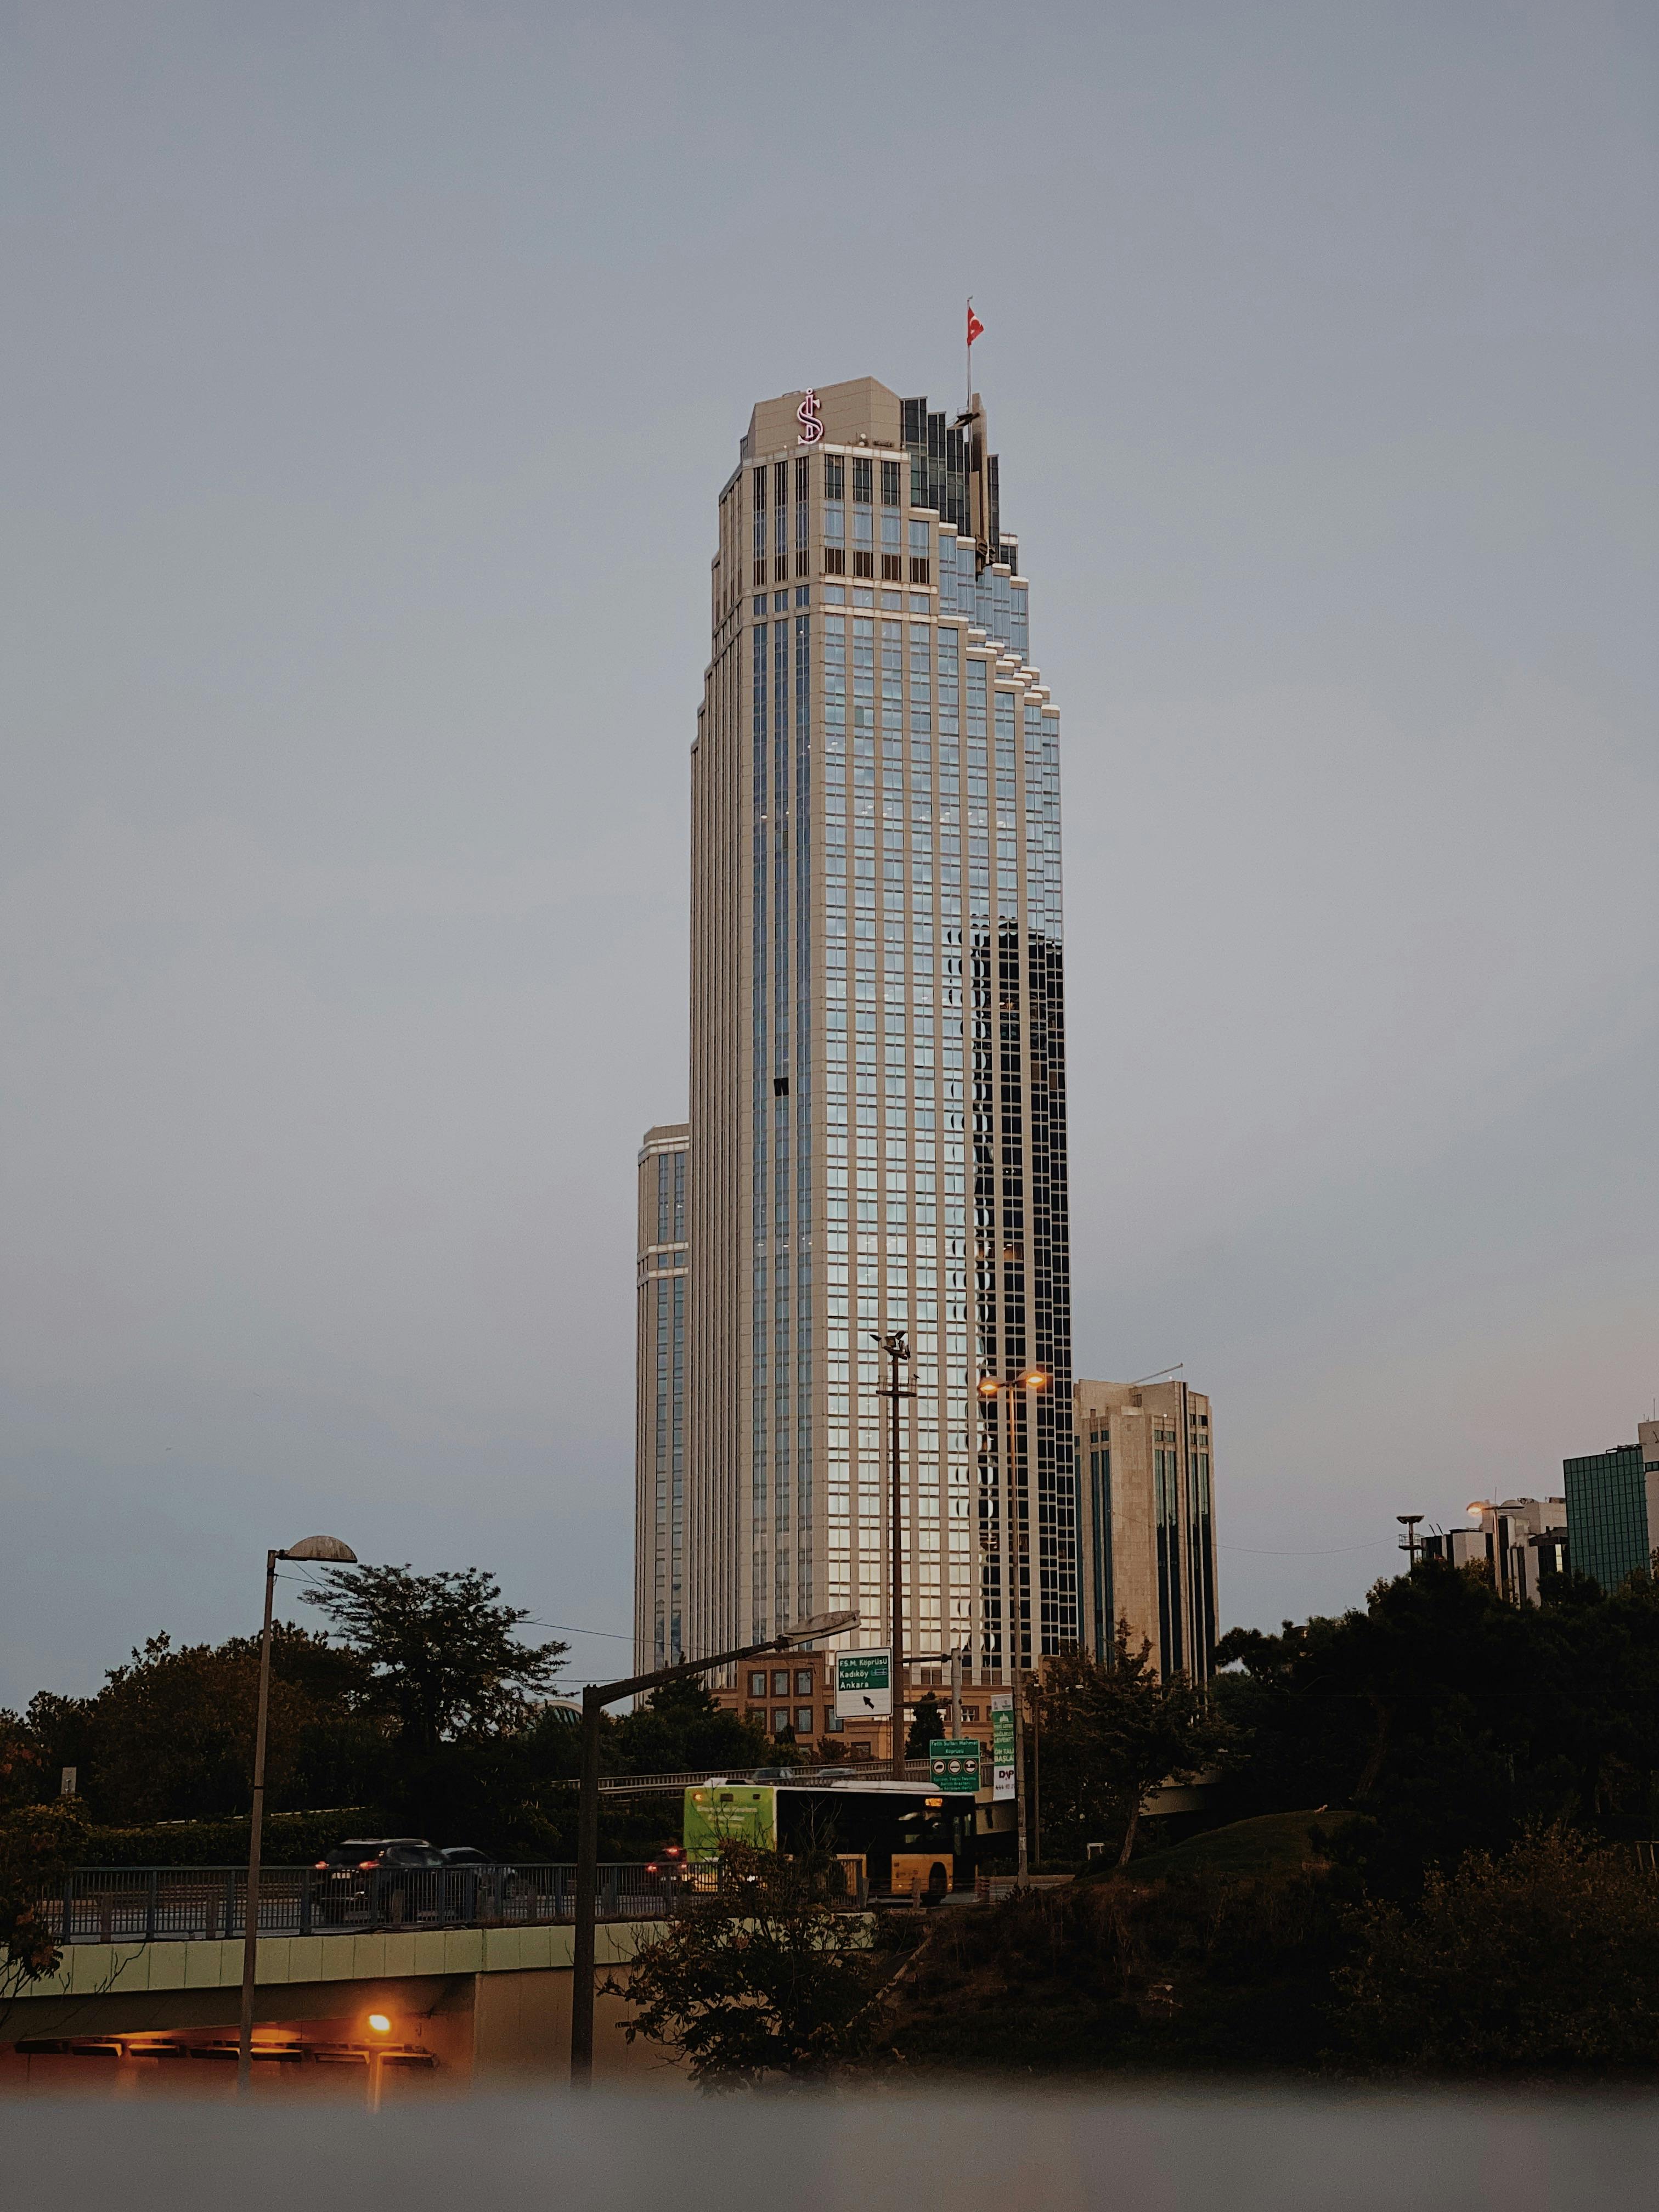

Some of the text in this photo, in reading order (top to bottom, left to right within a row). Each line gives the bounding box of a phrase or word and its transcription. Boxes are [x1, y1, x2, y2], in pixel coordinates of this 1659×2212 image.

[860, 1658, 887, 1667] Köprüsü
[840, 1670, 868, 1679] Kadıköy
[840, 1681, 869, 1689] Ankara
